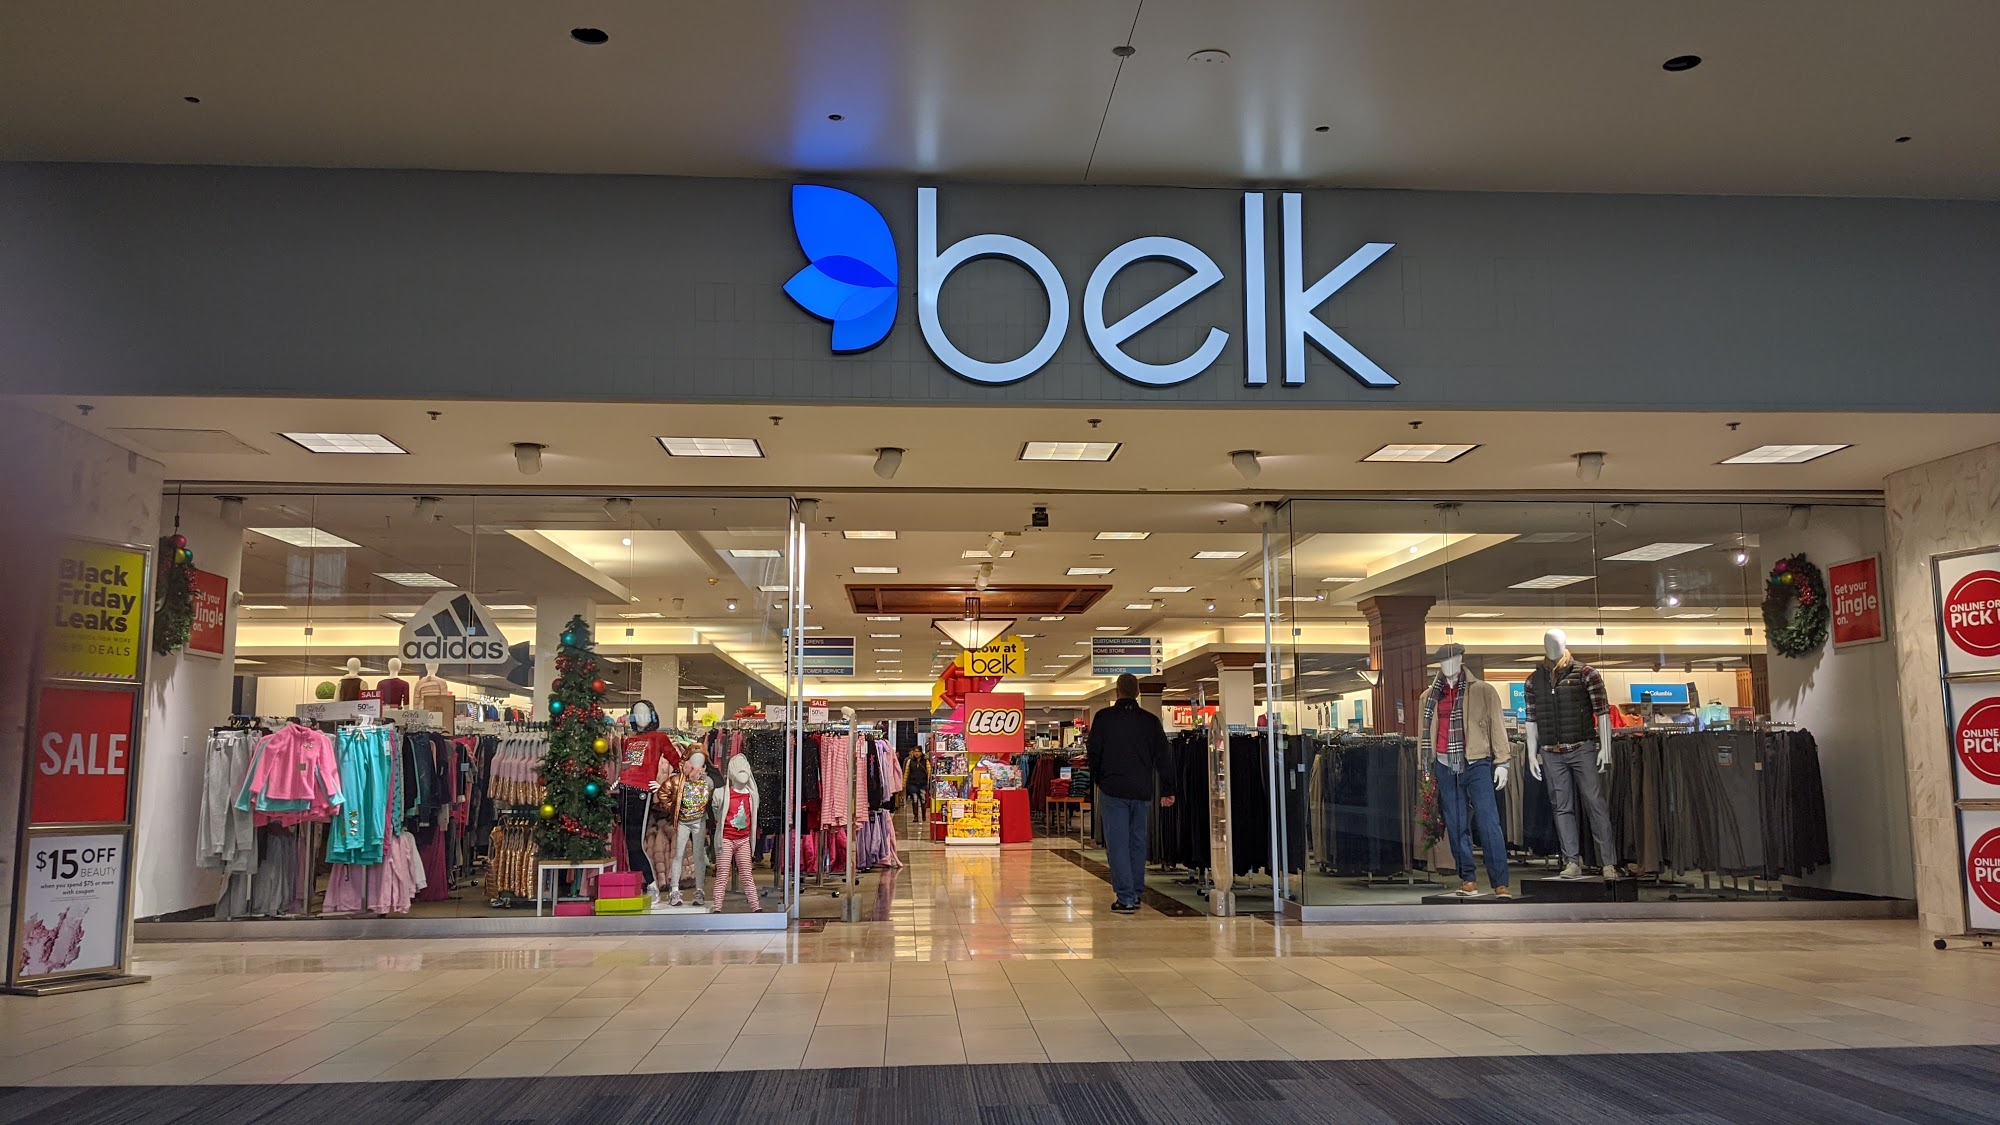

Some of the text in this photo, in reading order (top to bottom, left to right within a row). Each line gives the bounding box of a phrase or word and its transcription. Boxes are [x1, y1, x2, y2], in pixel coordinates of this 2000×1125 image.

[917, 187, 1400, 387] belk
[60, 559, 128, 587] Black
[1834, 581, 1867, 596] Get your
[58, 582, 137, 616] Friday
[207, 594, 220, 605] your
[1835, 592, 1877, 617] Jingle
[1950, 601, 1985, 613] ONLINE
[55, 604, 128, 633] Leaks
[193, 602, 224, 629] Jingle
[1836, 616, 1849, 625] on.
[1951, 610, 1993, 628] PICK
[192, 622, 203, 632] on.
[88, 644, 131, 657] DEALS
[403, 637, 504, 660] adidas
[977, 644, 1017, 653] ow at
[971, 653, 1017, 674] belk
[968, 710, 1021, 735] LEGO
[1962, 729, 1999, 738] ONLINE
[40, 731, 127, 775] SALE
[36, 848, 116, 880] $15 OFF
[80, 867, 117, 878] BEAUTY
[67, 881, 83, 889] spend
